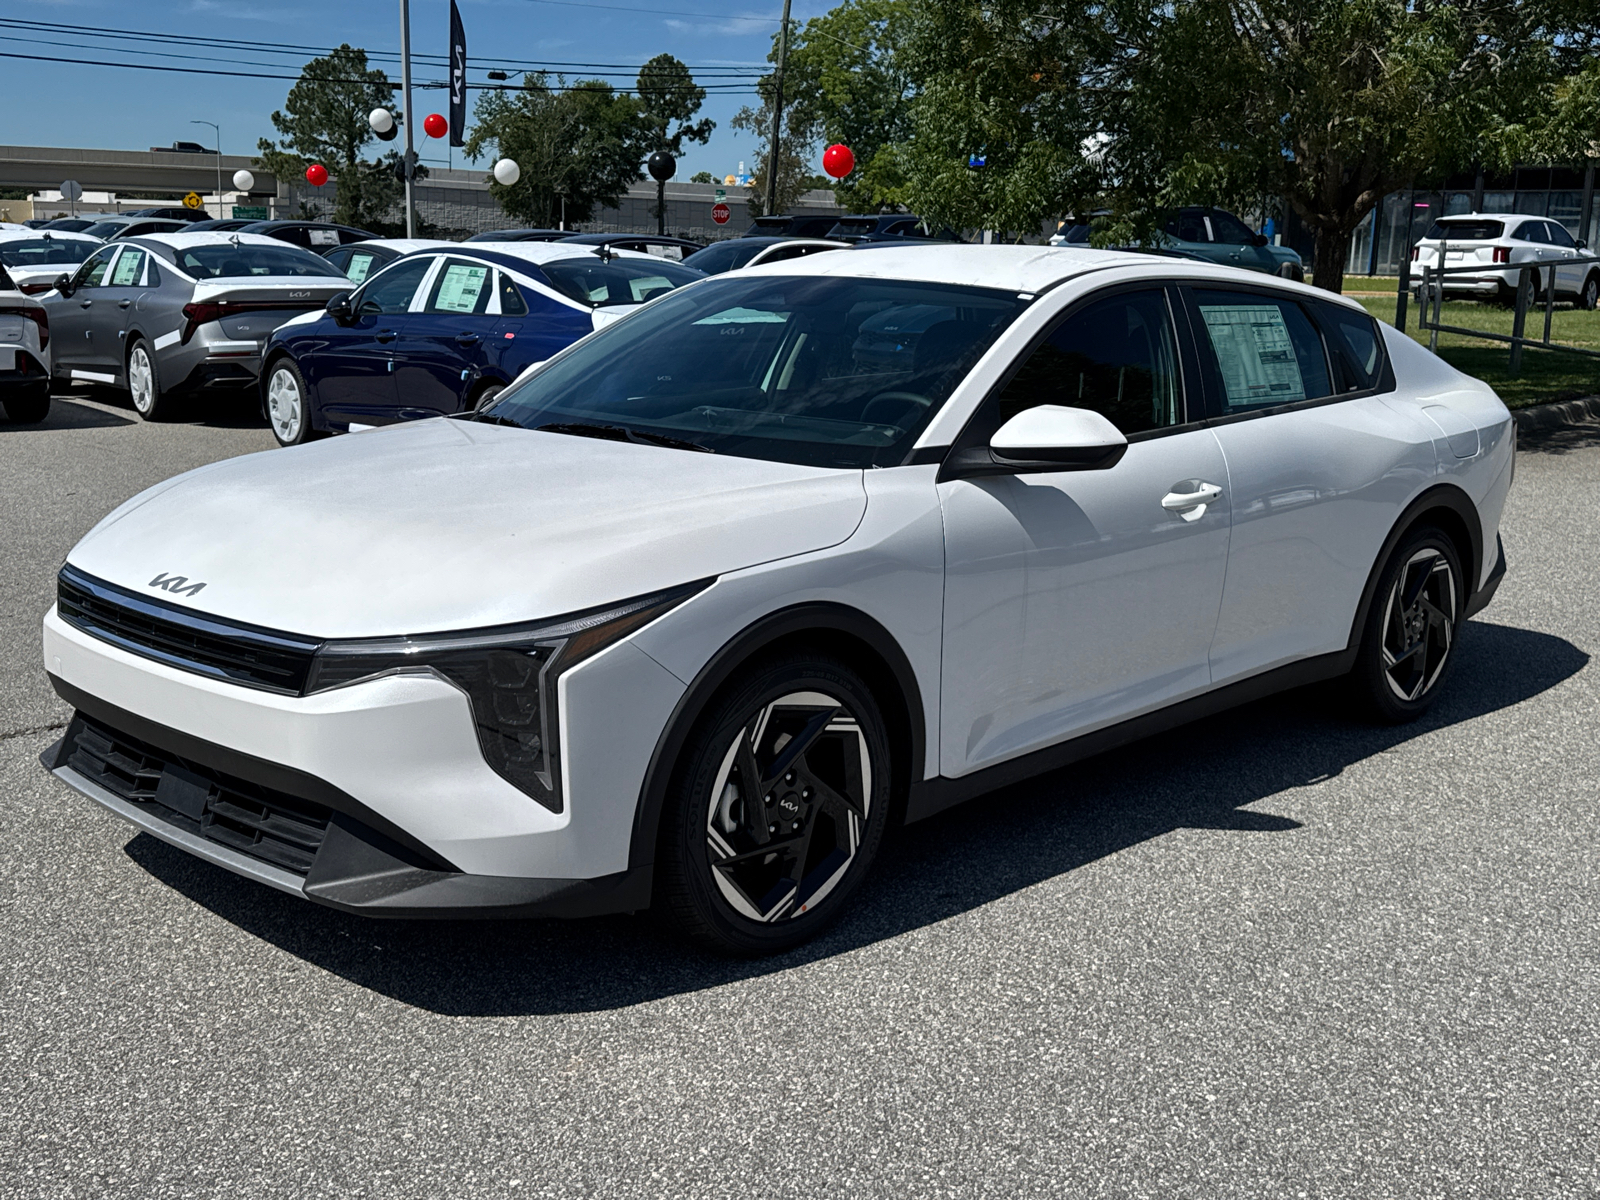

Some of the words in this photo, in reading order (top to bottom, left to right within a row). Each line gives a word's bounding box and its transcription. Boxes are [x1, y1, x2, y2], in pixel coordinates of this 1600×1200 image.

[452, 44, 463, 104] KIA
[713, 209, 730, 218] STOP
[720, 327, 745, 335] KIA
[148, 572, 208, 597] KIA
[689, 768, 708, 840] SOLUS
[780, 799, 799, 813] KIA
[869, 786, 889, 854] KUMHO
